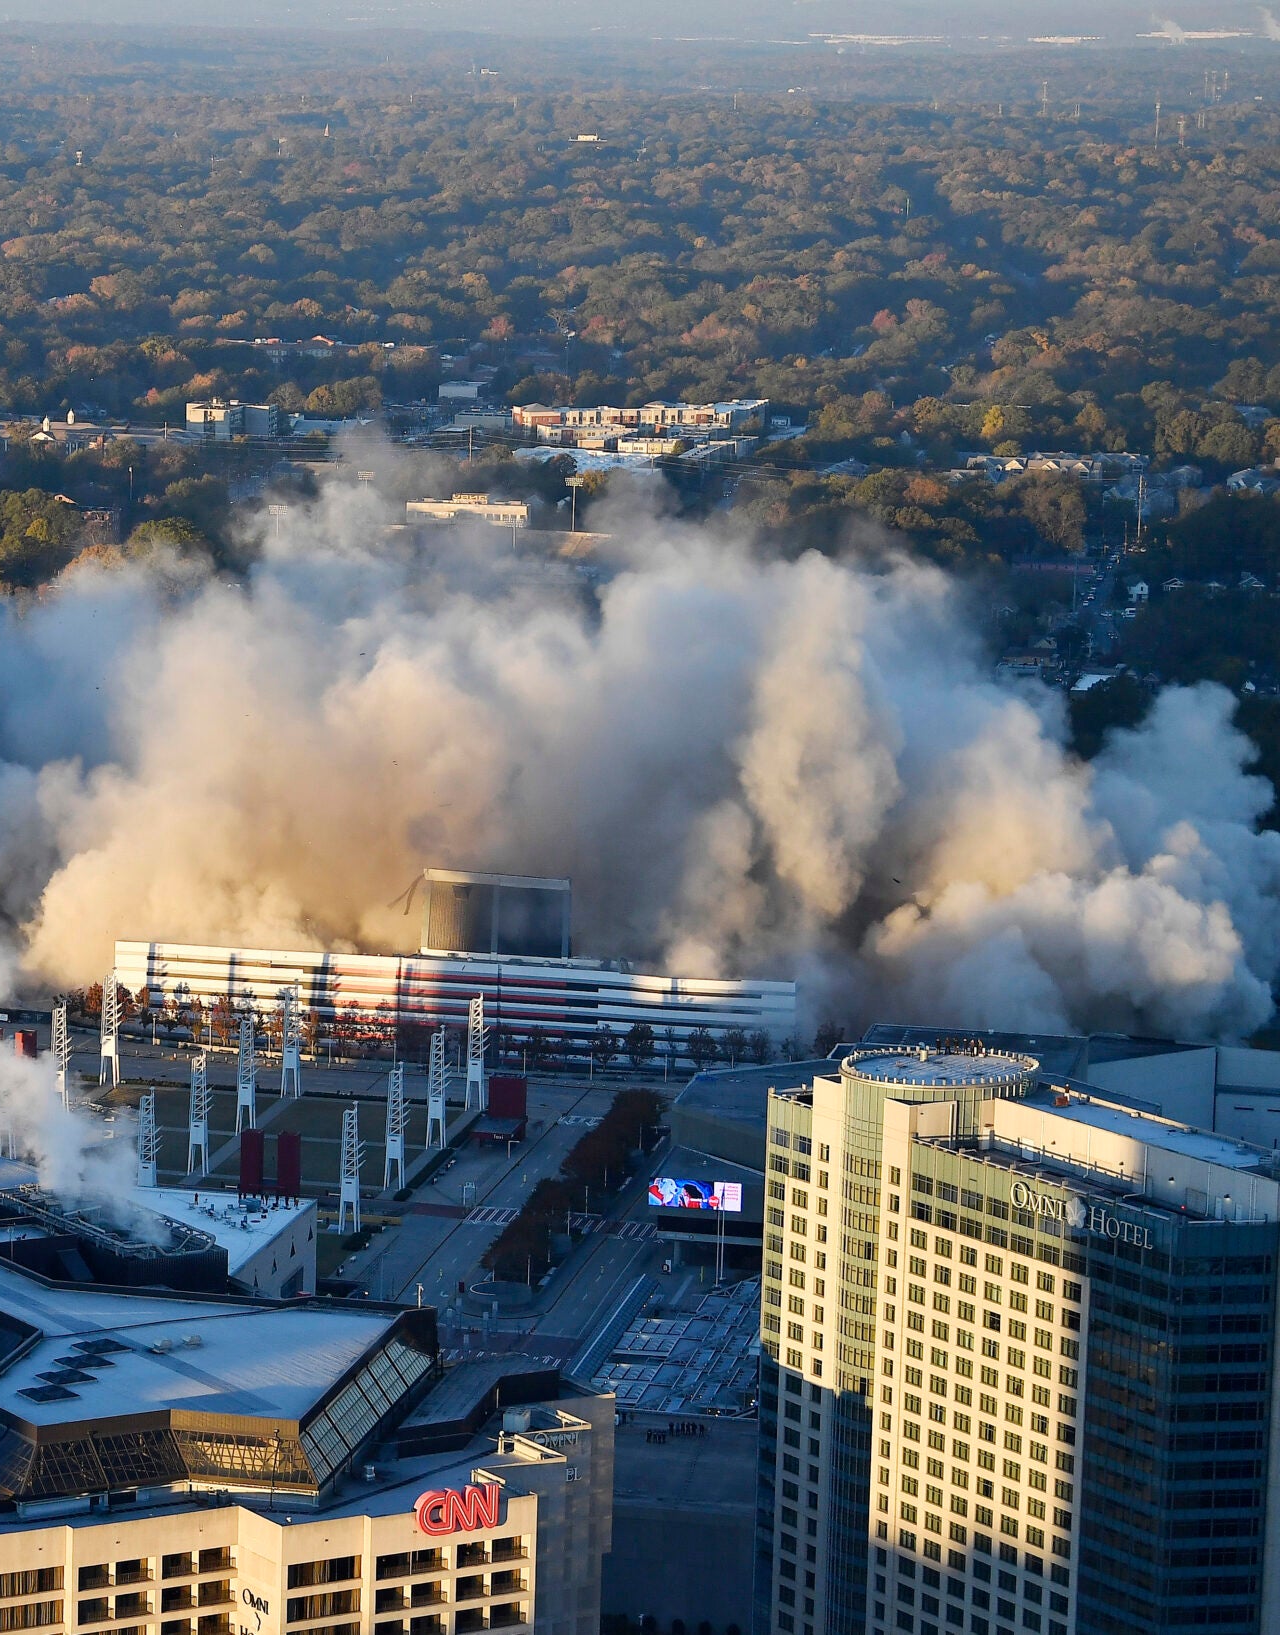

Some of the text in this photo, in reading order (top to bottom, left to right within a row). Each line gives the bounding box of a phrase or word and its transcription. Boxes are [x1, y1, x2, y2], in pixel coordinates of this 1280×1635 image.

[1010, 1181, 1153, 1250] OMNI HOTEL
[414, 1482, 500, 1536] CNN
